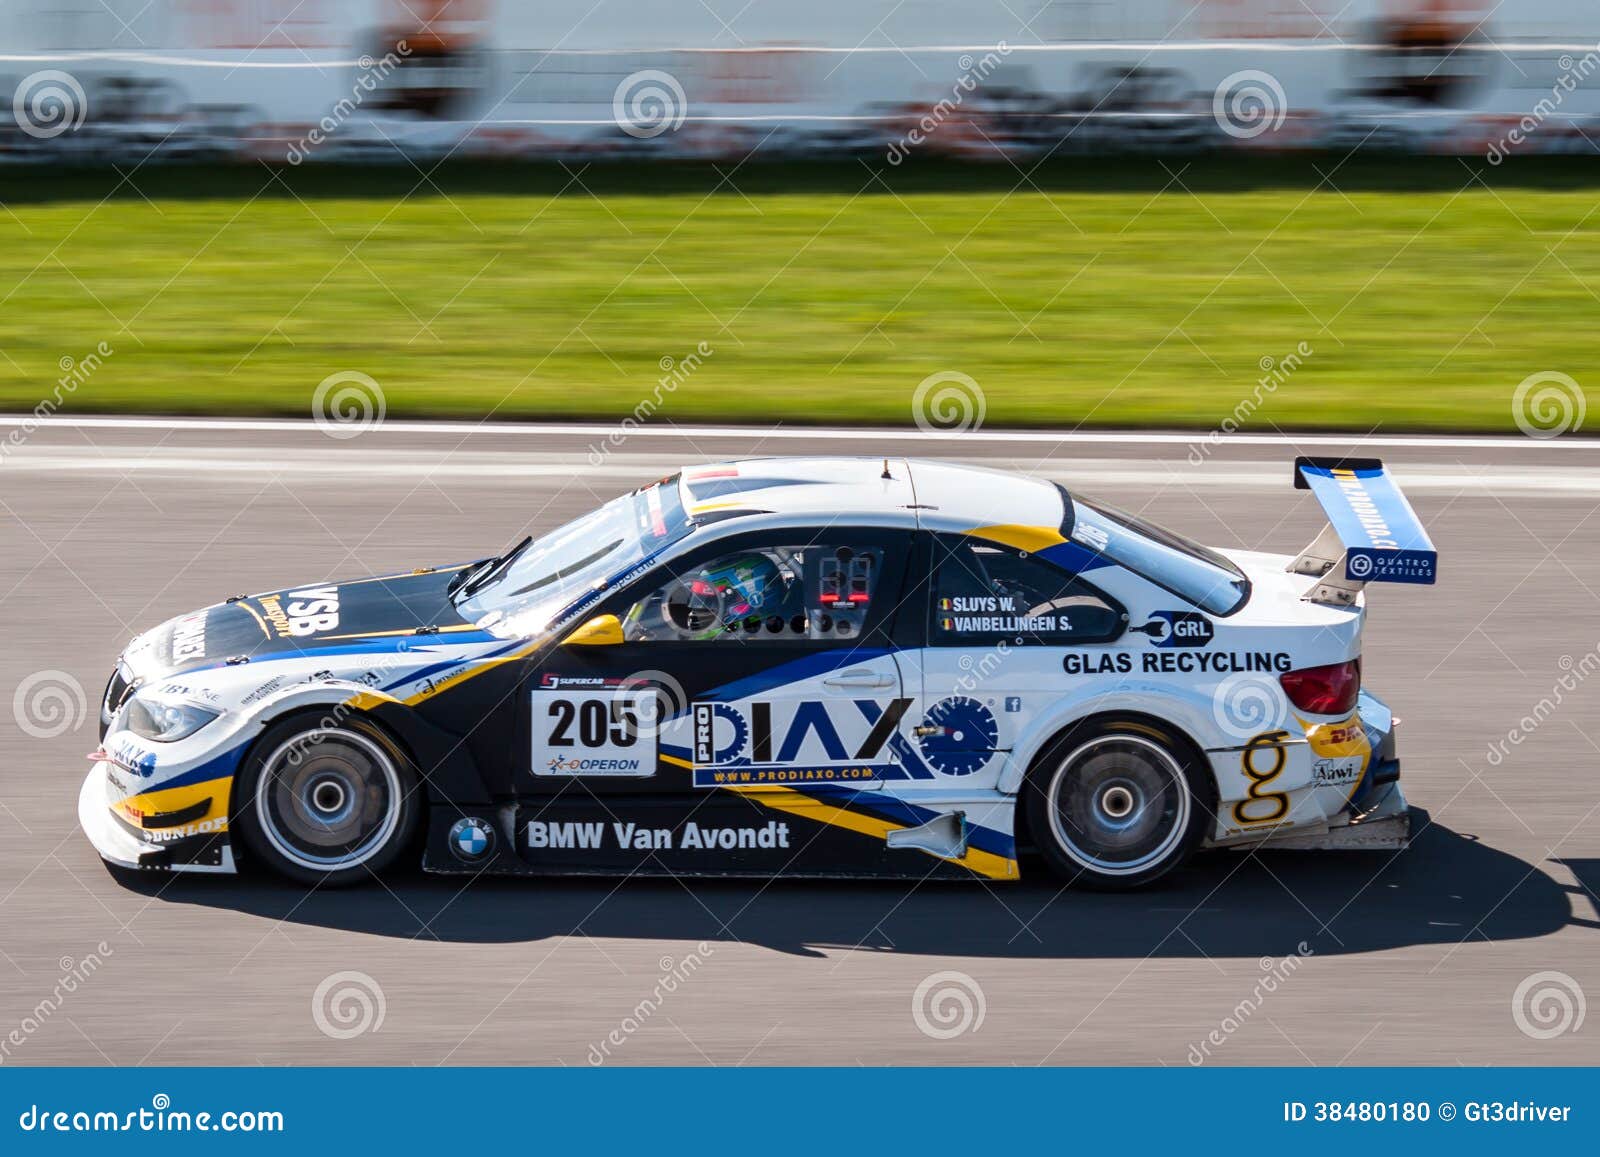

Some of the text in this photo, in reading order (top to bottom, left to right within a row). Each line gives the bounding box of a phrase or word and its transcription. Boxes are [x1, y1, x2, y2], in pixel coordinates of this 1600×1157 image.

[1374, 566, 1433, 577] TEXTILES
[1376, 557, 1430, 567] QUATRO
[286, 586, 340, 637] VSB
[952, 598, 1016, 612] SLUYS W.
[954, 617, 1073, 632] VANBELLINGEN S.
[1174, 621, 1210, 637] GRL
[1063, 652, 1292, 674] GLAS RECYCLING
[548, 699, 638, 748] 205
[697, 706, 710, 762] PRO
[714, 768, 873, 782] WWW.PRODIAXO.COM
[152, 815, 229, 843] DUNLOP
[528, 820, 790, 849] BMW Van Avondt
